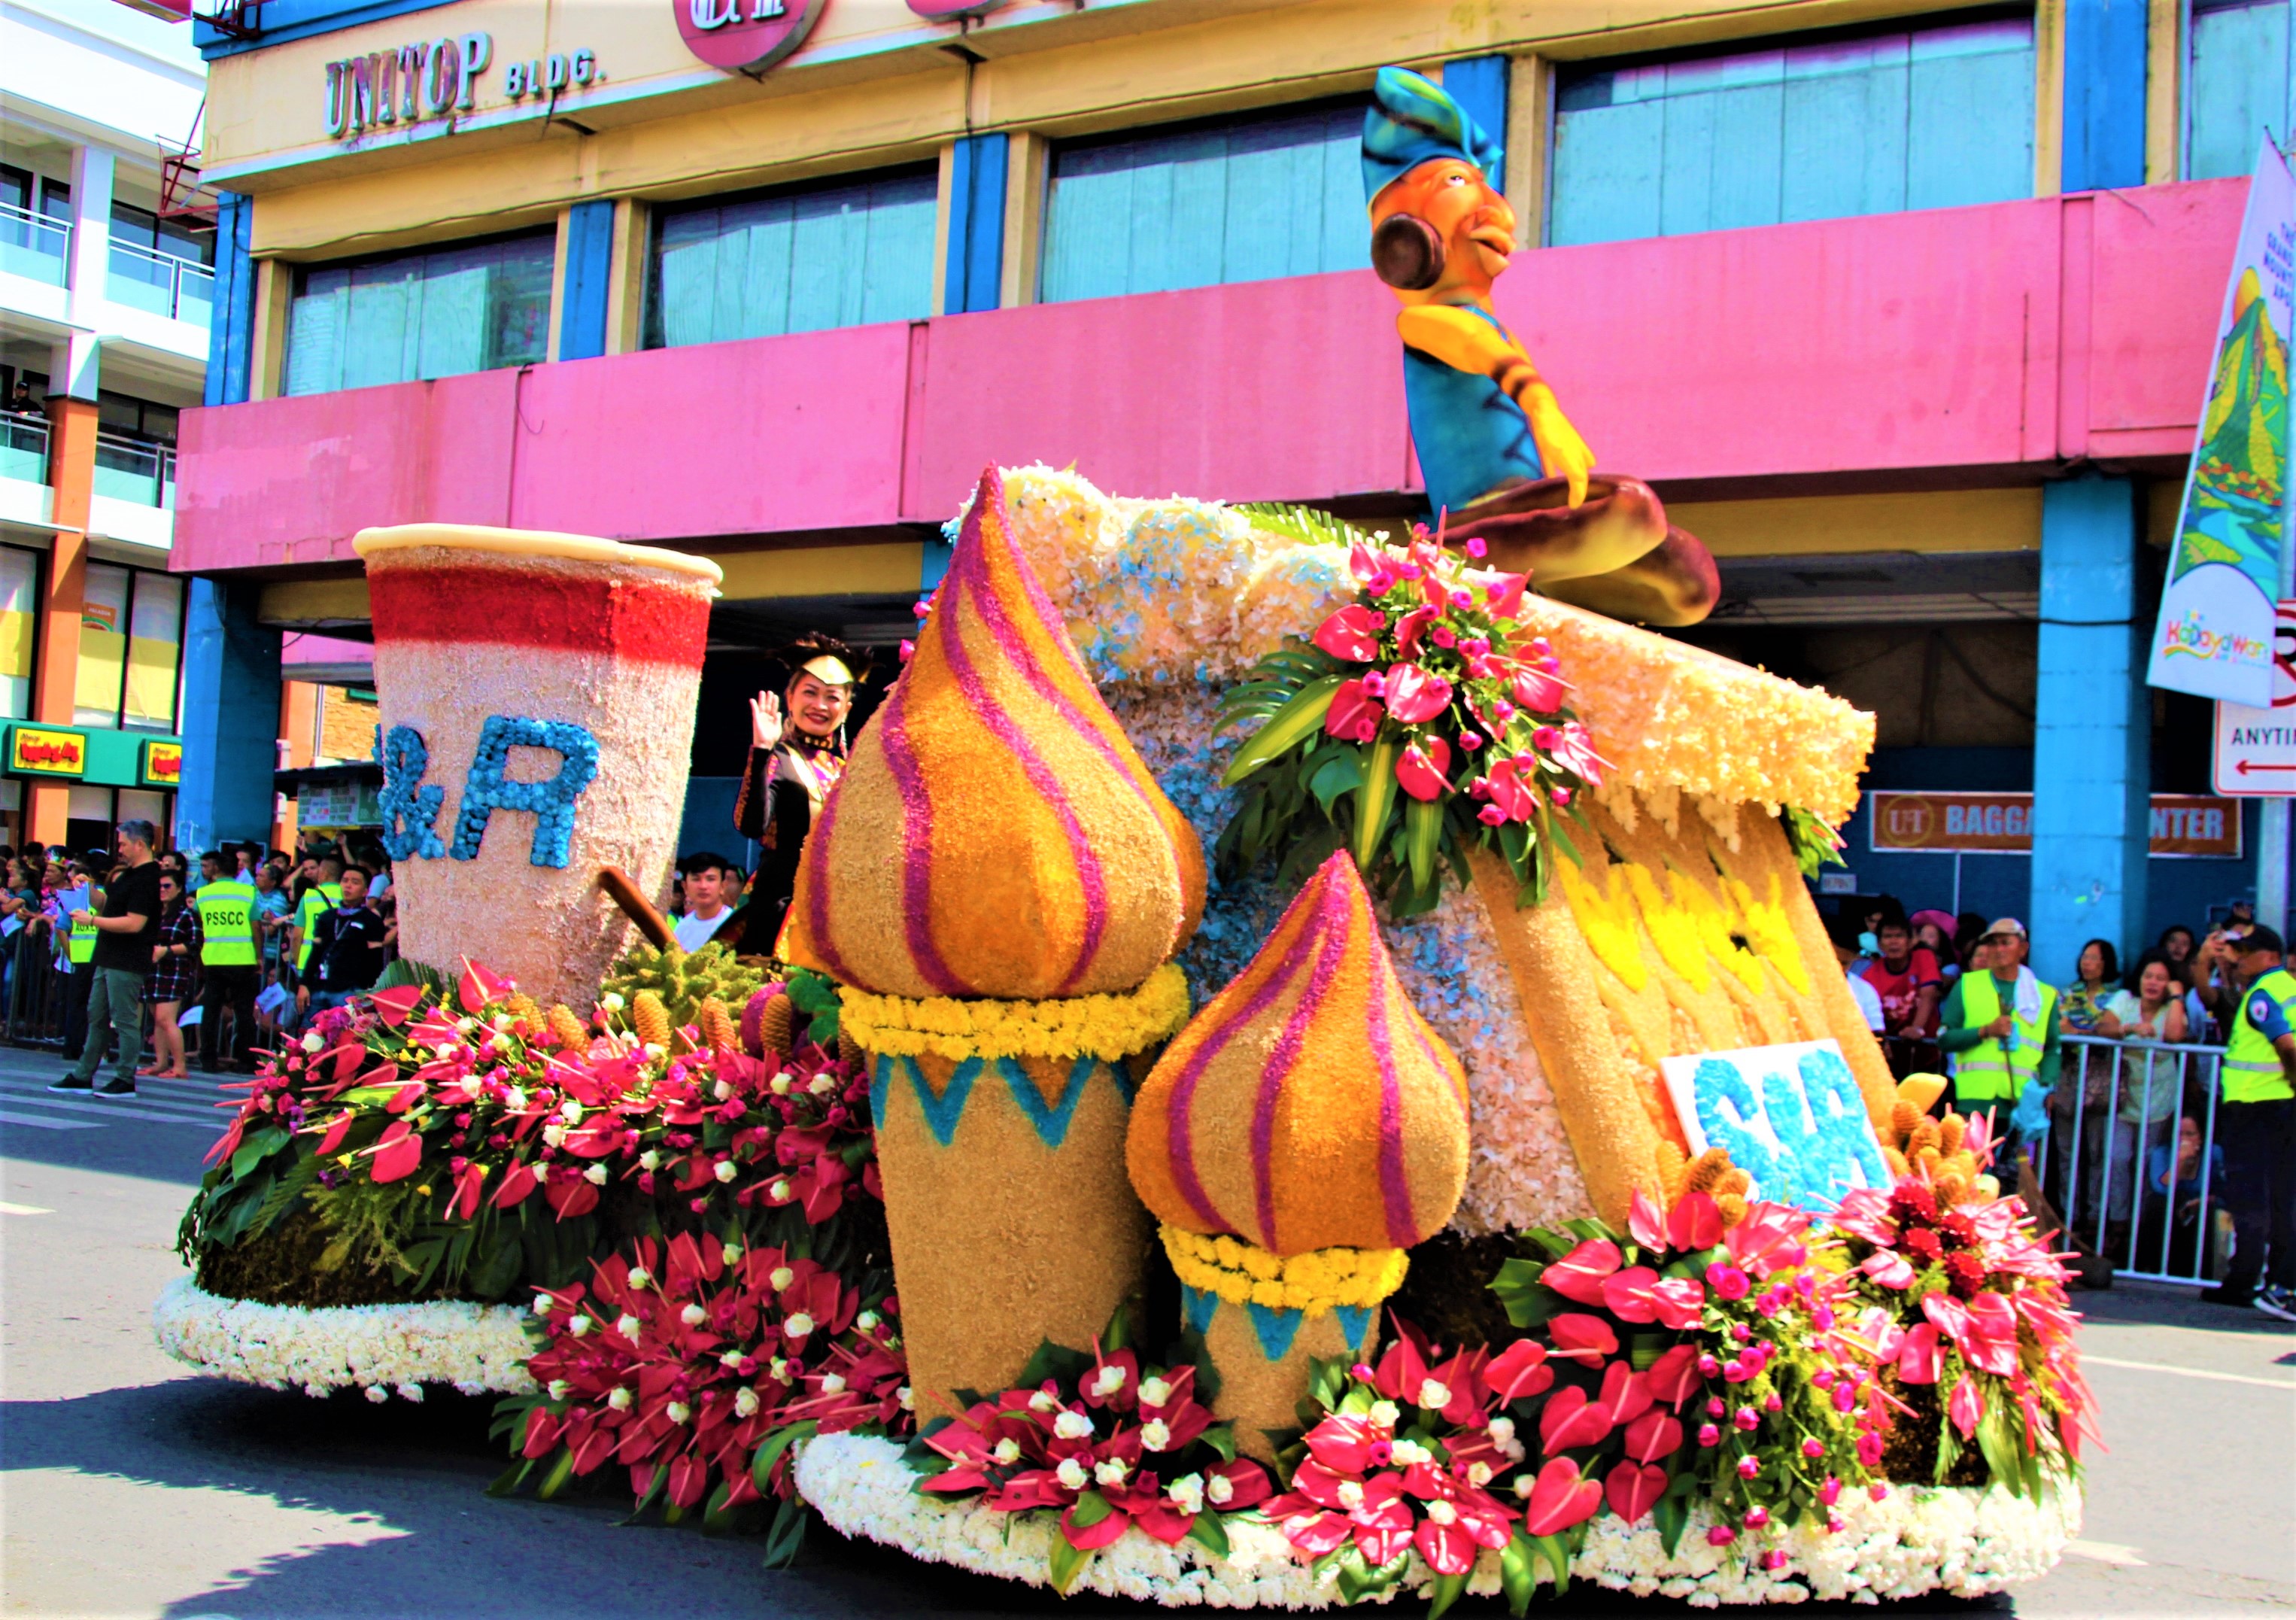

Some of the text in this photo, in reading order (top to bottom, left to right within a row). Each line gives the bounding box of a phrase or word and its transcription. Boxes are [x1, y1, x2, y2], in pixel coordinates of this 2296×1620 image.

[323, 31, 606, 138] UNITOP BLDG.
[205, 911, 244, 926] PSSCC
